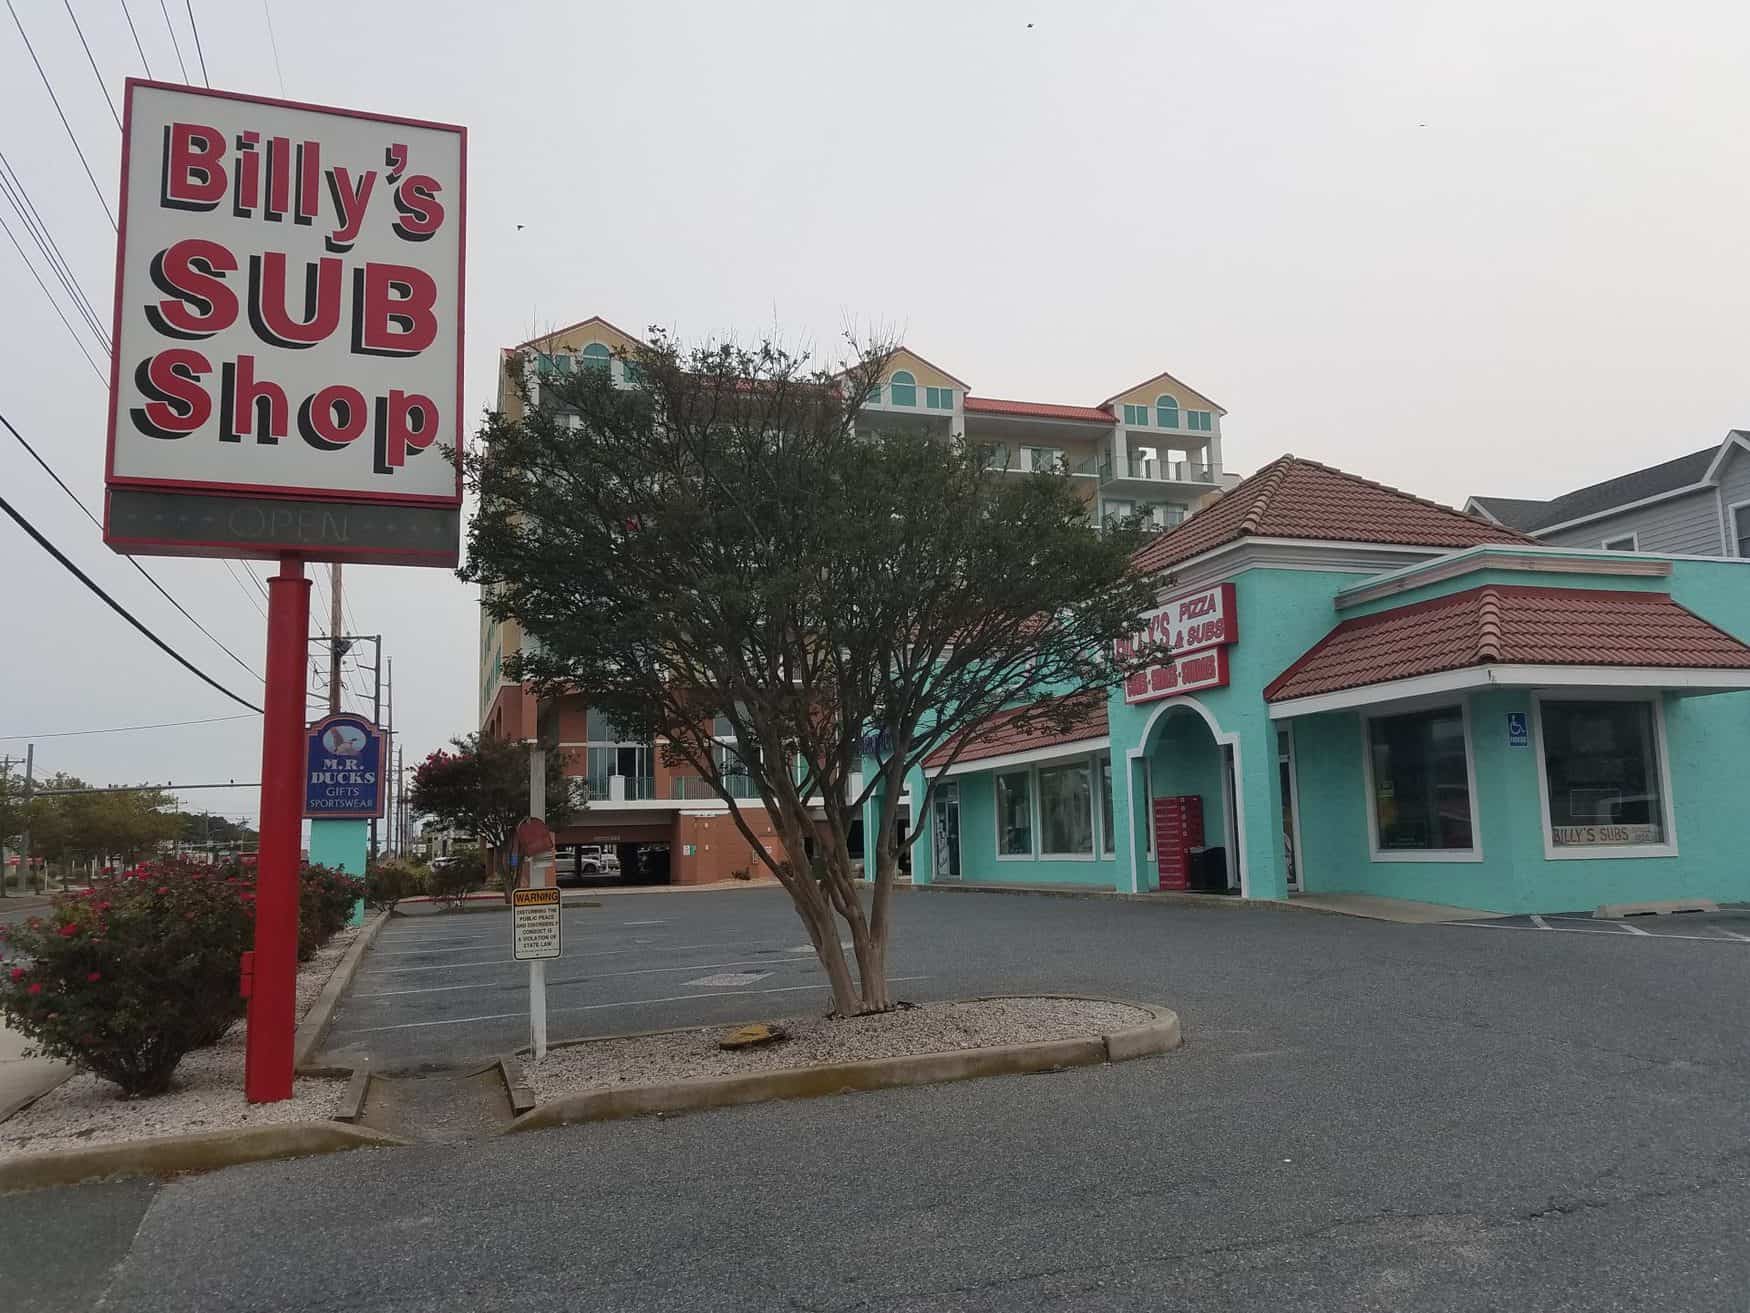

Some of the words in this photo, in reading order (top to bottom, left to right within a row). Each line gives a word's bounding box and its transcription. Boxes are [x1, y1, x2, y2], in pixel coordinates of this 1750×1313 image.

[160, 122, 445, 253] Billy's
[144, 239, 438, 358] SUB
[130, 348, 440, 475] Shop
[228, 505, 350, 544] OPEN
[1179, 593, 1216, 622] PIZZA
[1187, 618, 1224, 646] SUBS
[323, 759, 365, 770] M.R.
[311, 771, 376, 784] DUCKS
[326, 787, 360, 797] GIFTS
[310, 799, 373, 808] SPORTSWEAR
[1552, 827, 1595, 843] BILLY'S
[1600, 827, 1629, 841] SUBS
[515, 891, 559, 903] WARNING
